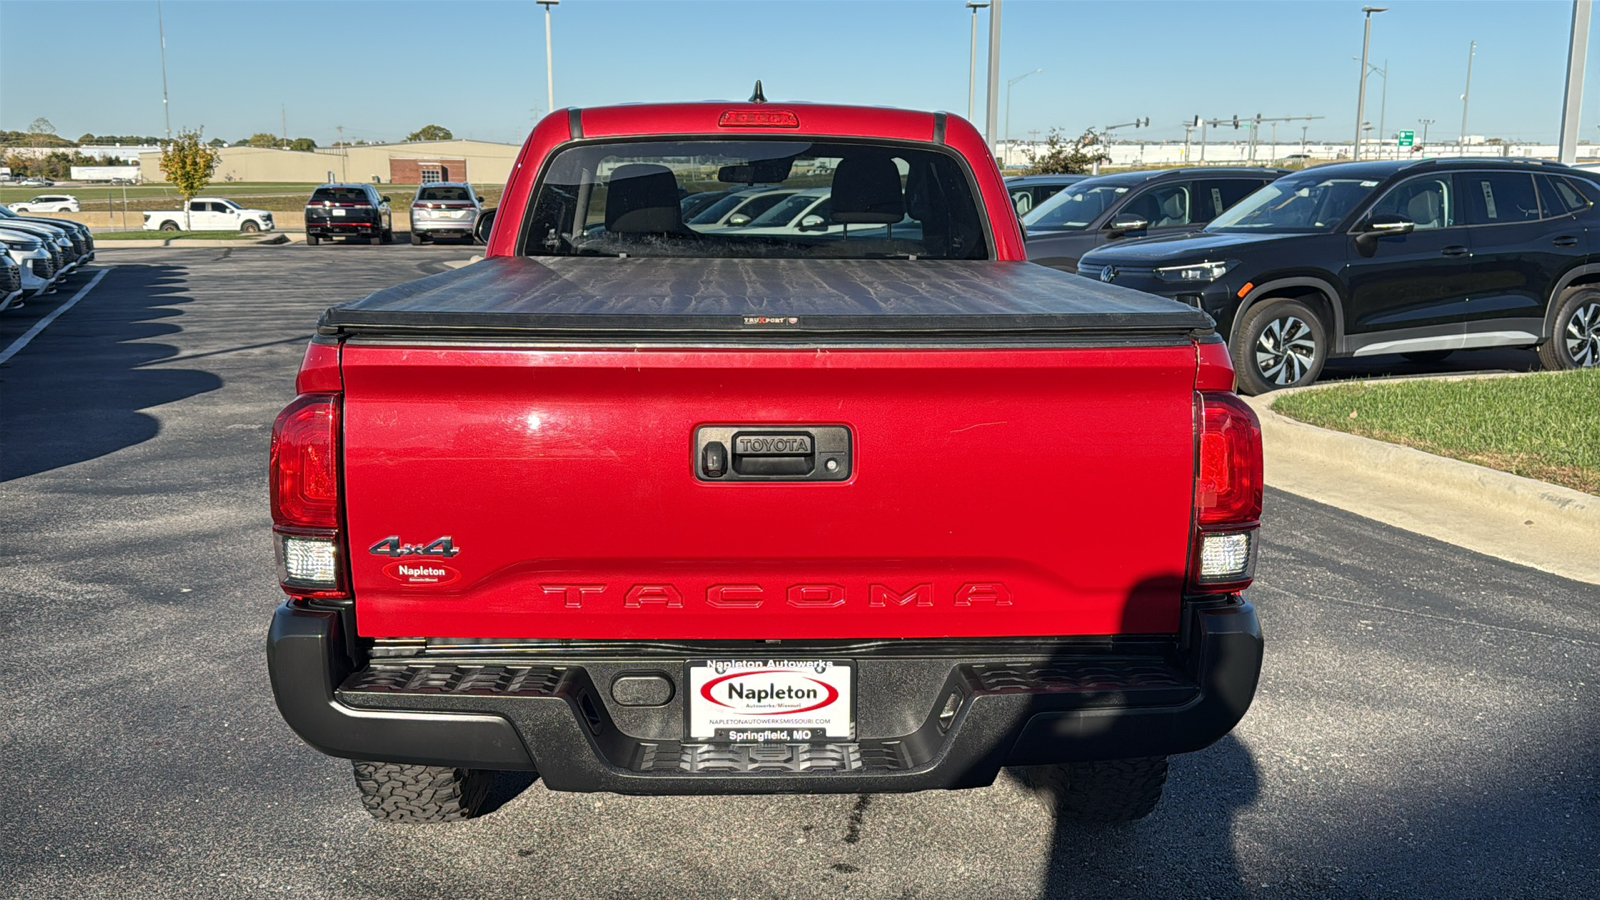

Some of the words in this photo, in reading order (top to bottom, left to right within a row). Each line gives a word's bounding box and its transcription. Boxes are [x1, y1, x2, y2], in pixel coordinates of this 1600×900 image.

[743, 316, 784, 324] TRUXPORT
[740, 438, 809, 452] TOYOTA
[368, 535, 460, 557] 4x4
[398, 565, 446, 577] Napleton
[538, 582, 1013, 608] TACOMA
[706, 659, 763, 669] Napleton
[766, 659, 834, 669] Autowerks
[728, 682, 817, 703] Napleton
[729, 730, 791, 742] Springfield,
[793, 730, 811, 740] MO
